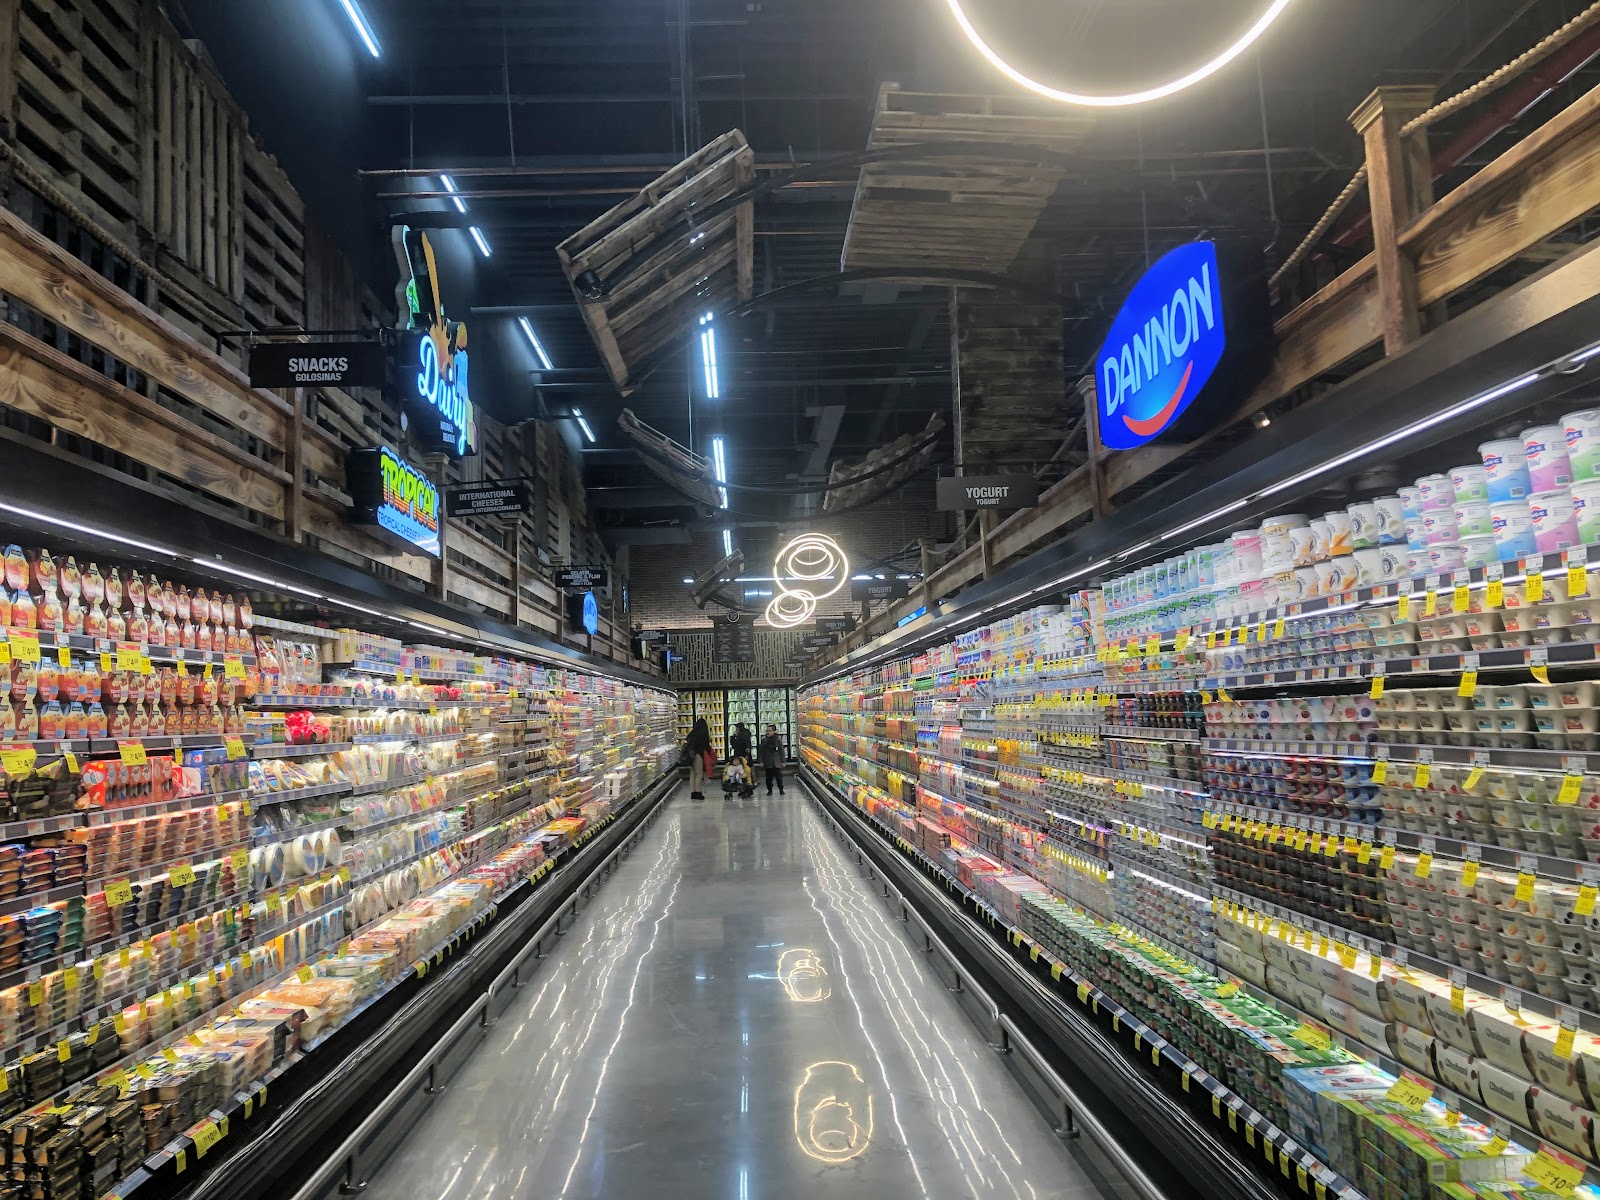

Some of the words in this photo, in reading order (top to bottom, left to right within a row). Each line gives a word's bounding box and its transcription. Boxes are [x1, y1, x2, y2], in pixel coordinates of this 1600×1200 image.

[1103, 262, 1214, 416] DANNON
[288, 357, 348, 372] SNACKS
[295, 372, 342, 381] GOLOSINAS
[418, 335, 467, 456] Dairy
[381, 454, 437, 533] TROPICAL
[459, 489, 516, 501] INTERNATIONAL
[965, 486, 1009, 499] YOGURT
[471, 498, 504, 508] CHEESES
[377, 511, 401, 533] TROPICAL
[401, 524, 418, 542] CHEESE
[1528, 579, 1542, 588] $7.99
[1570, 572, 1585, 582] $7.99
[868, 586, 892, 594] YOGURT
[1488, 585, 1502, 595] $7.99
[1394, 990, 1415, 1004] Chobani
[1485, 1027, 1510, 1045] Chobani
[1445, 1058, 1468, 1076] Chobani
[1489, 1081, 1515, 1101] Chobani
[1545, 1109, 1575, 1130] Chobani
